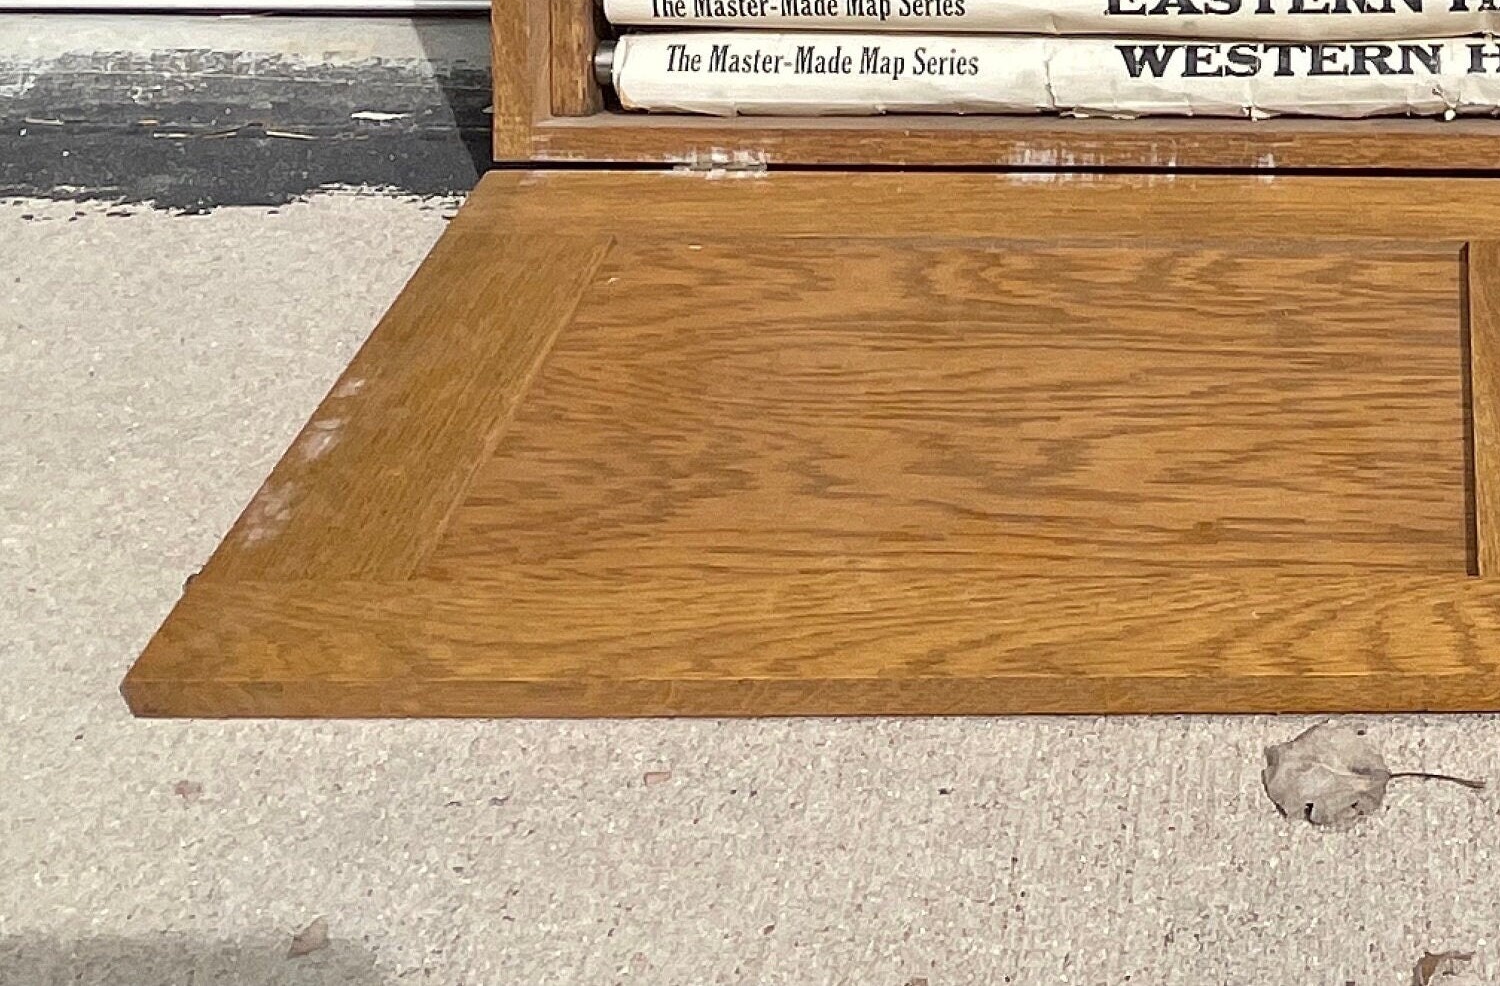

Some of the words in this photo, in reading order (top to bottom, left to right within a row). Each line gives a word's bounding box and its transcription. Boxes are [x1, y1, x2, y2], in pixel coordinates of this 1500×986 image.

[666, 43, 702, 72] The
[707, 44, 853, 75] Master-Made
[858, 46, 905, 81] Map
[912, 46, 979, 76] Series
[1114, 42, 1445, 79] WESTERN
